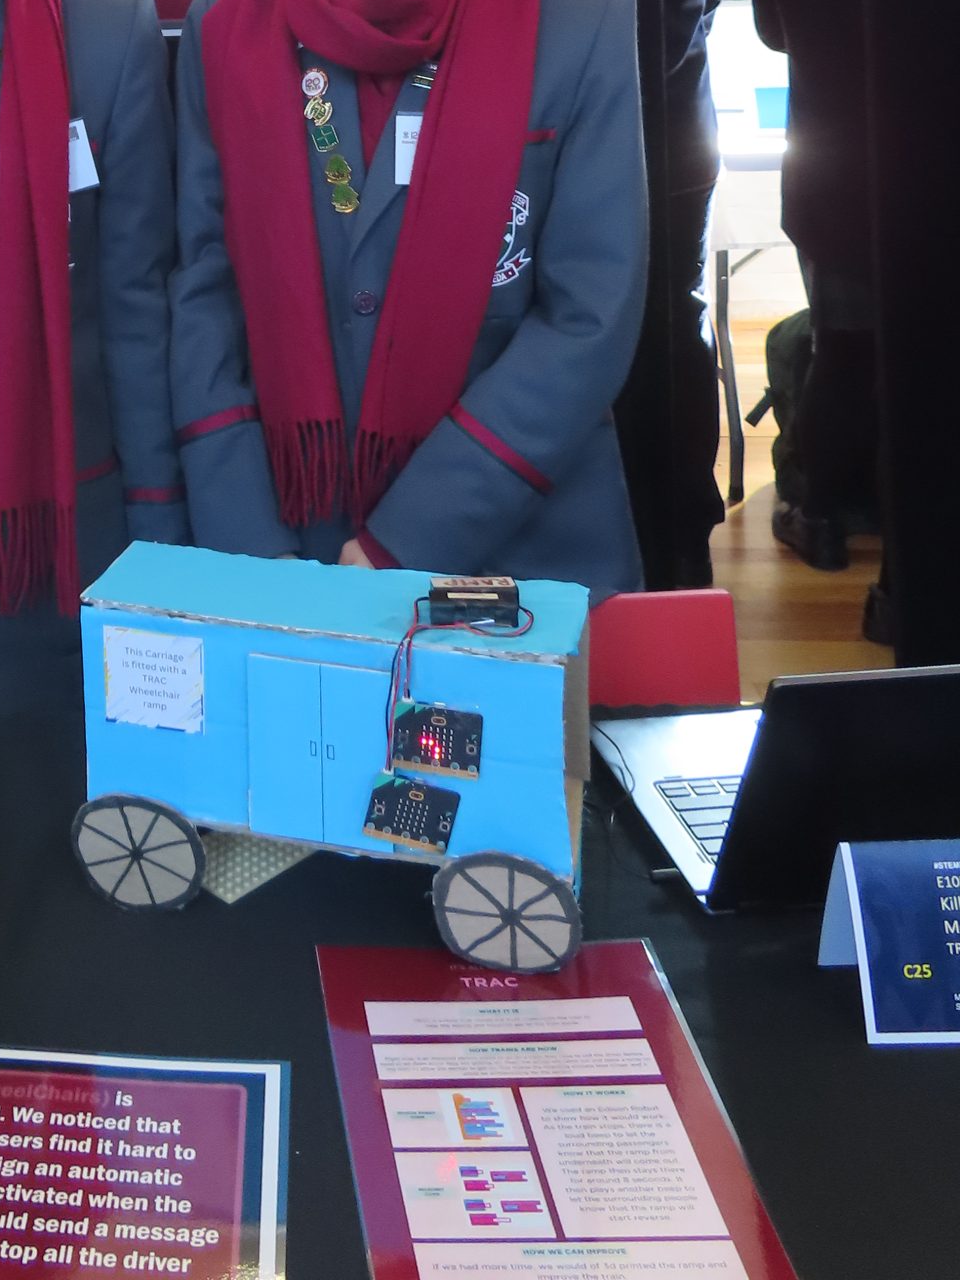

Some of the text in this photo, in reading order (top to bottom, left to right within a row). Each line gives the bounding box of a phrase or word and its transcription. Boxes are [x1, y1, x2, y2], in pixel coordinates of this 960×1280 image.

[124, 646, 185, 663] This Carriage
[122, 660, 130, 668] is
[131, 660, 157, 671] fitted
[159, 664, 180, 675] with
[142, 674, 167, 685] TRAC
[129, 686, 181, 700] Wheelchair
[143, 701, 167, 711] ramp
[903, 964, 932, 979] C25
[460, 977, 519, 988] TRAC
[115, 1089, 133, 1108] is
[11, 1106, 45, 1125] We
[49, 1111, 131, 1132] noticed
[136, 1116, 182, 1135] that
[48, 1134, 92, 1154] find
[96, 1138, 113, 1156] it
[117, 1141, 168, 1160] hard
[174, 1144, 197, 1161] to
[34, 1163, 62, 1178] an
[68, 1164, 183, 1187] automatic
[88, 1192, 148, 1212] when
[154, 1195, 192, 1214] the
